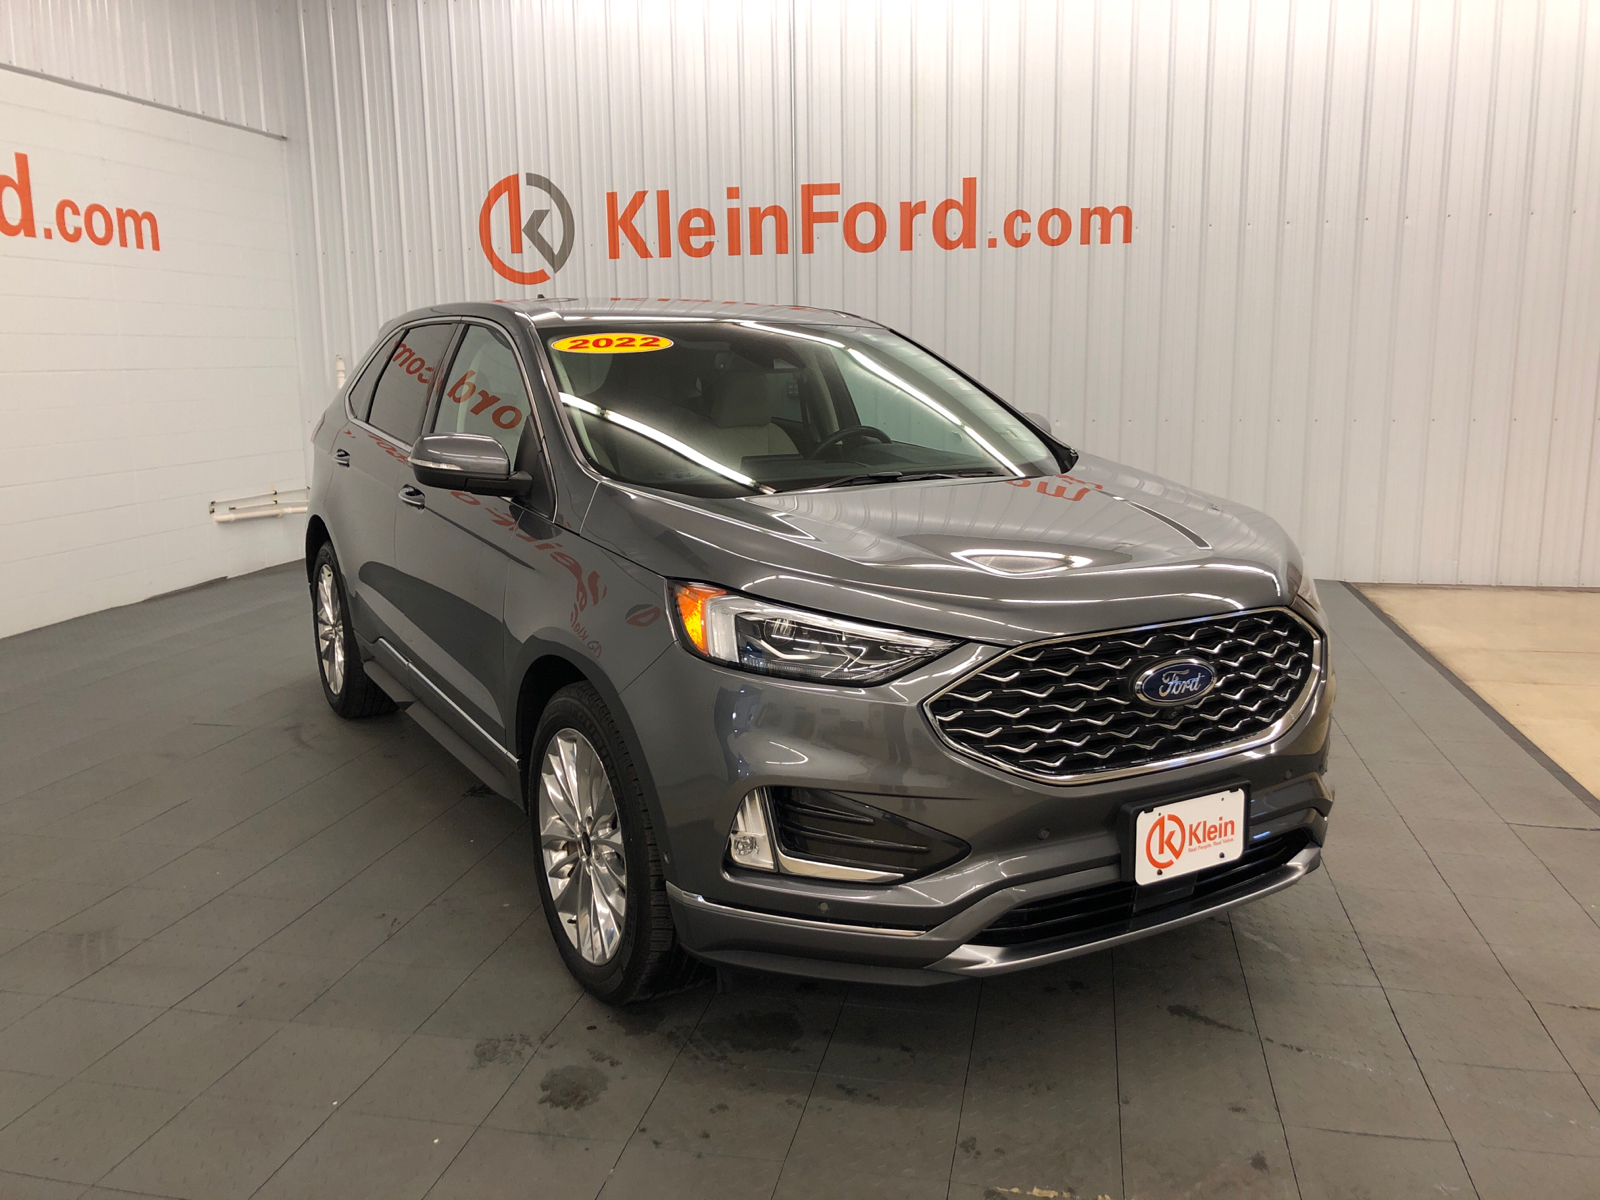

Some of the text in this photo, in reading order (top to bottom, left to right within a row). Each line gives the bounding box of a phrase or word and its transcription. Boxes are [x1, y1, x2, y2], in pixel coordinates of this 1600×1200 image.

[606, 177, 1133, 260] KleinFord.com
[567, 337, 661, 350] 2022
[1159, 669, 1203, 697] Ford
[1188, 816, 1235, 846] Klein
